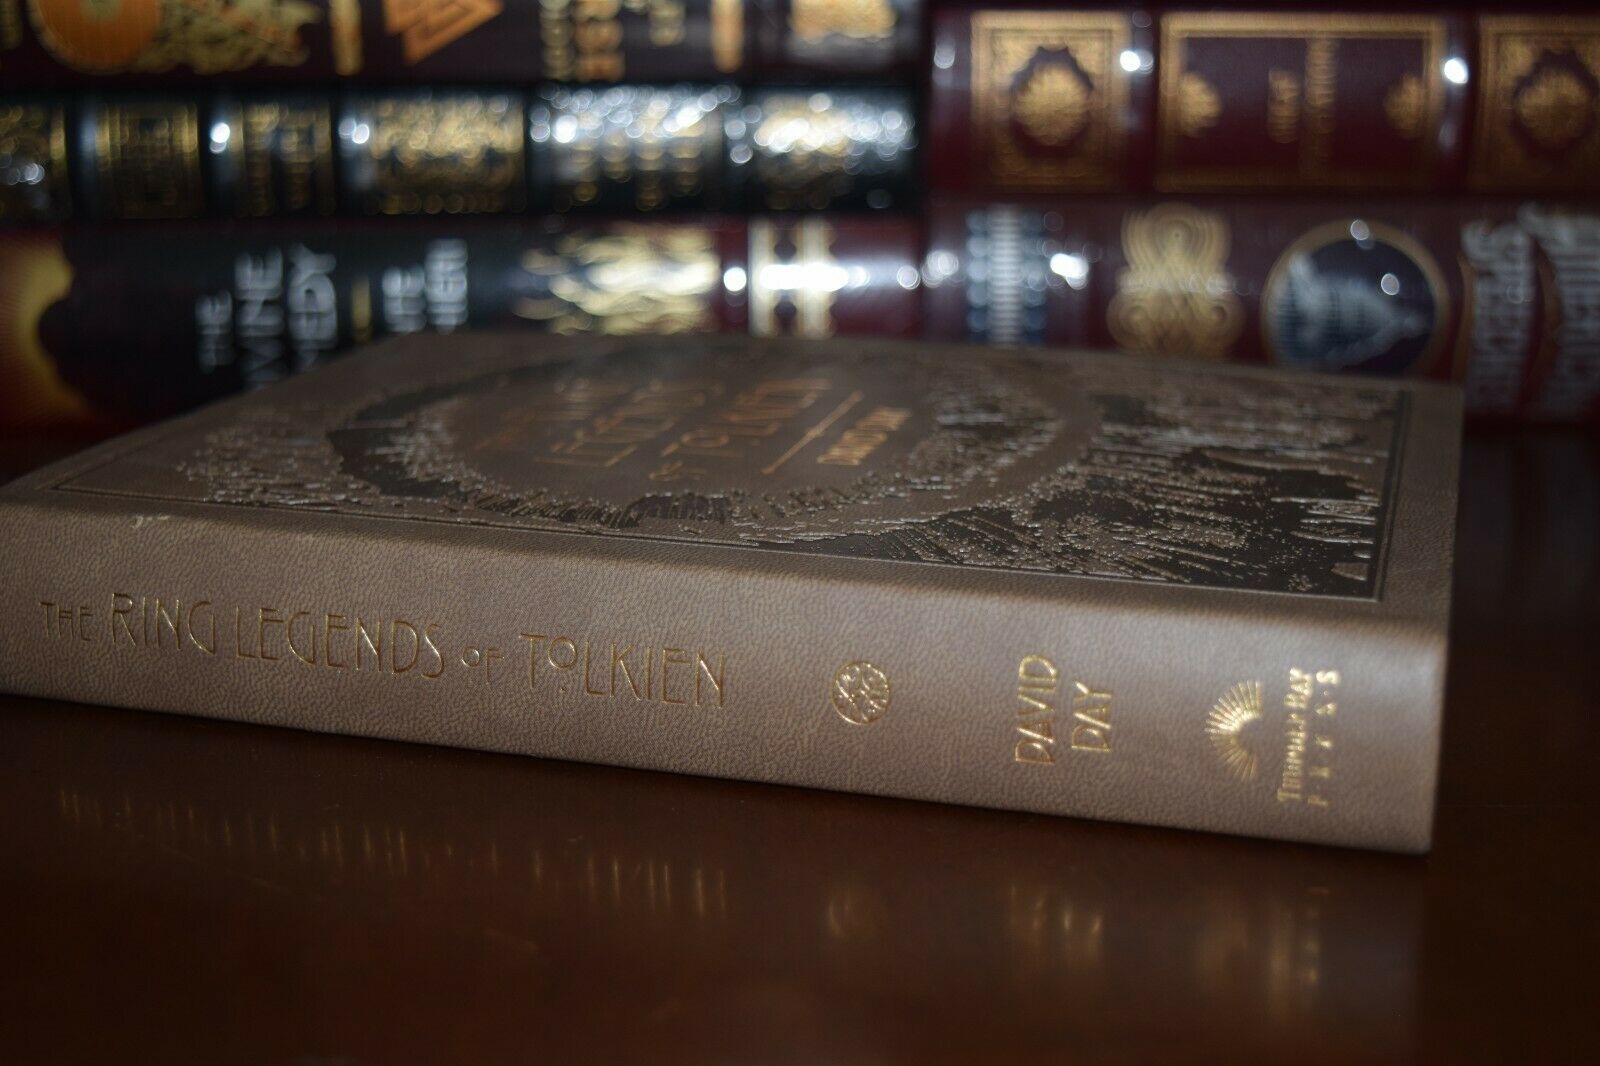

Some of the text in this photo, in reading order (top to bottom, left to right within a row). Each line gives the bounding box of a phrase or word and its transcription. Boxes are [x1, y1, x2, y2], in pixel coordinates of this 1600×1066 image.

[39, 592, 726, 709] THE RING LEGENDS OF TOLKIEN
[1014, 655, 1058, 765] DAVID
[1071, 680, 1113, 753] DAY
